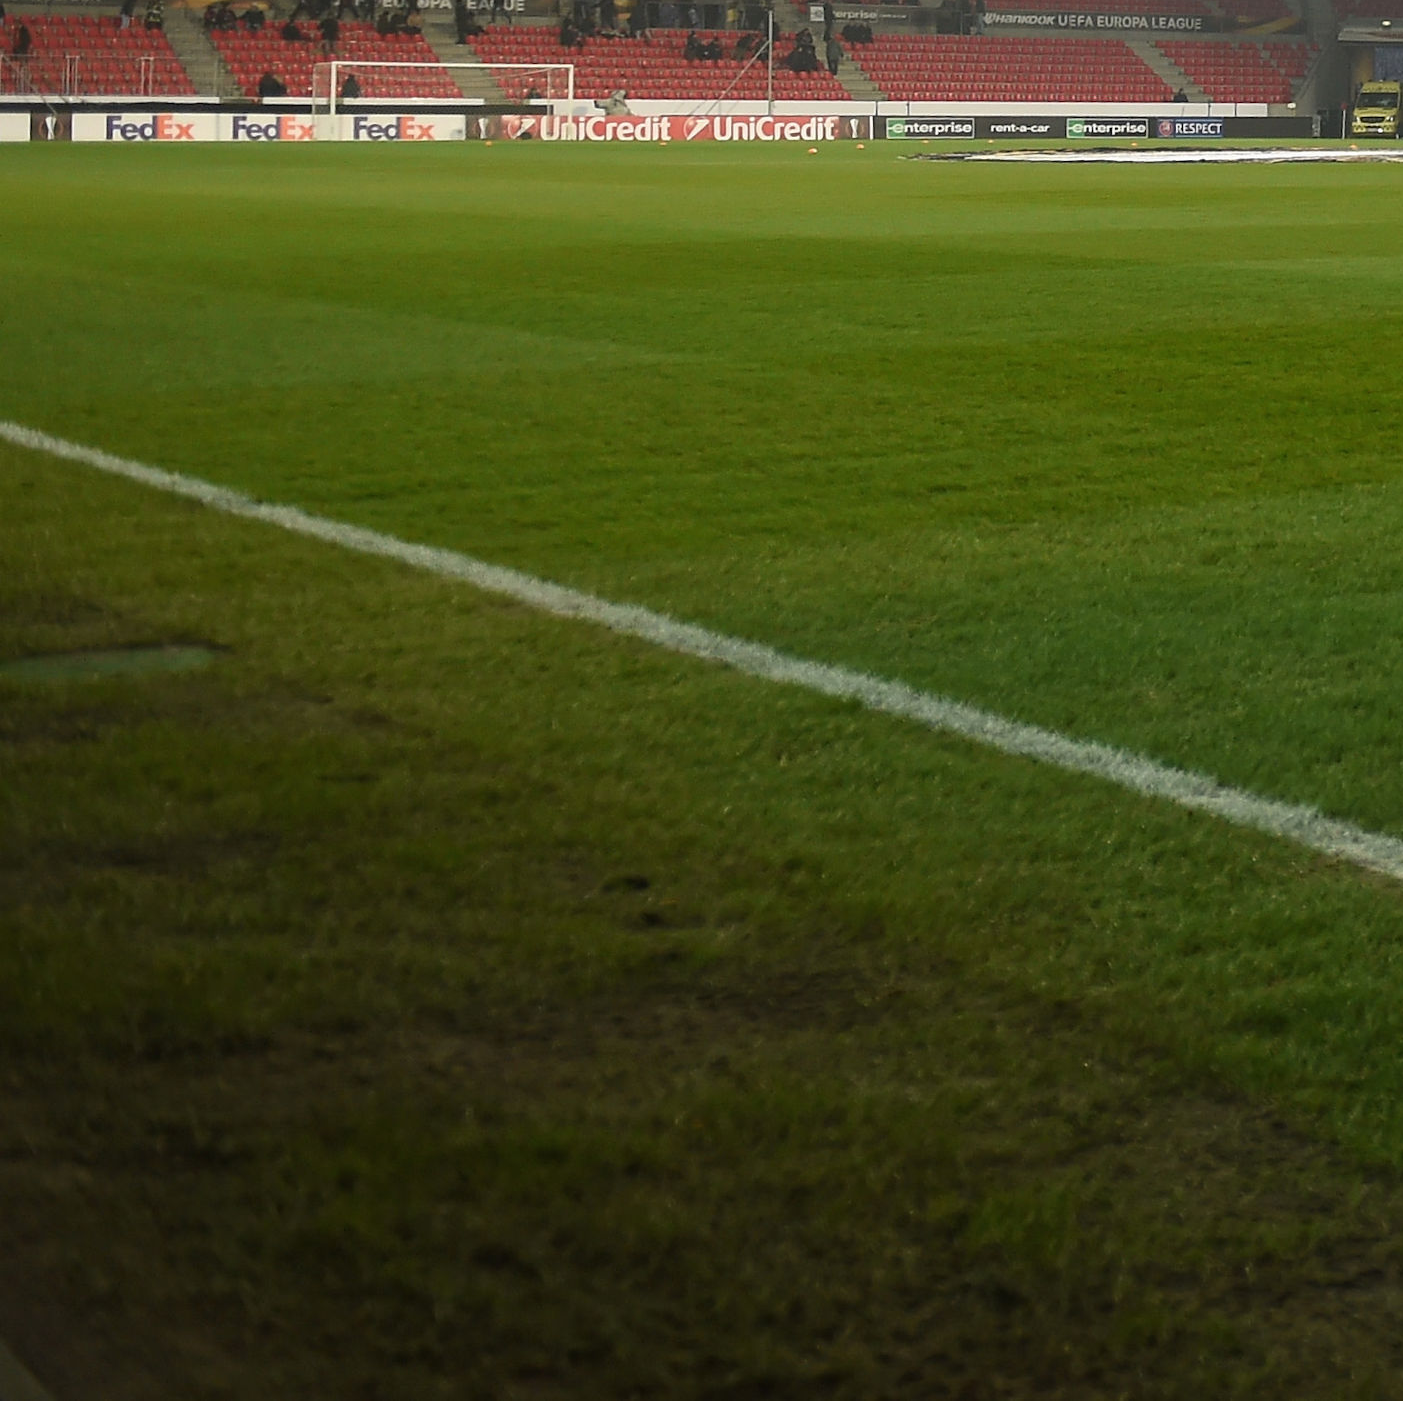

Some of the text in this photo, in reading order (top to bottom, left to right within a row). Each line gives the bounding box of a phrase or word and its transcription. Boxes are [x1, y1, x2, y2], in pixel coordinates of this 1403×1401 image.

[1058, 14, 1094, 27] UEFA
[1097, 15, 1149, 28] EUROPA
[1151, 17, 1202, 30] LEAGUE
[105, 114, 195, 141] FedEx
[232, 115, 315, 141] FedEx
[353, 116, 435, 141] FedEx
[540, 115, 672, 141] UniCredit
[713, 115, 835, 141] UniCredit
[889, 121, 1051, 136] enterprise rent-a-car
[1069, 122, 1147, 136] enterprise
[1175, 122, 1223, 135] RESPECT
